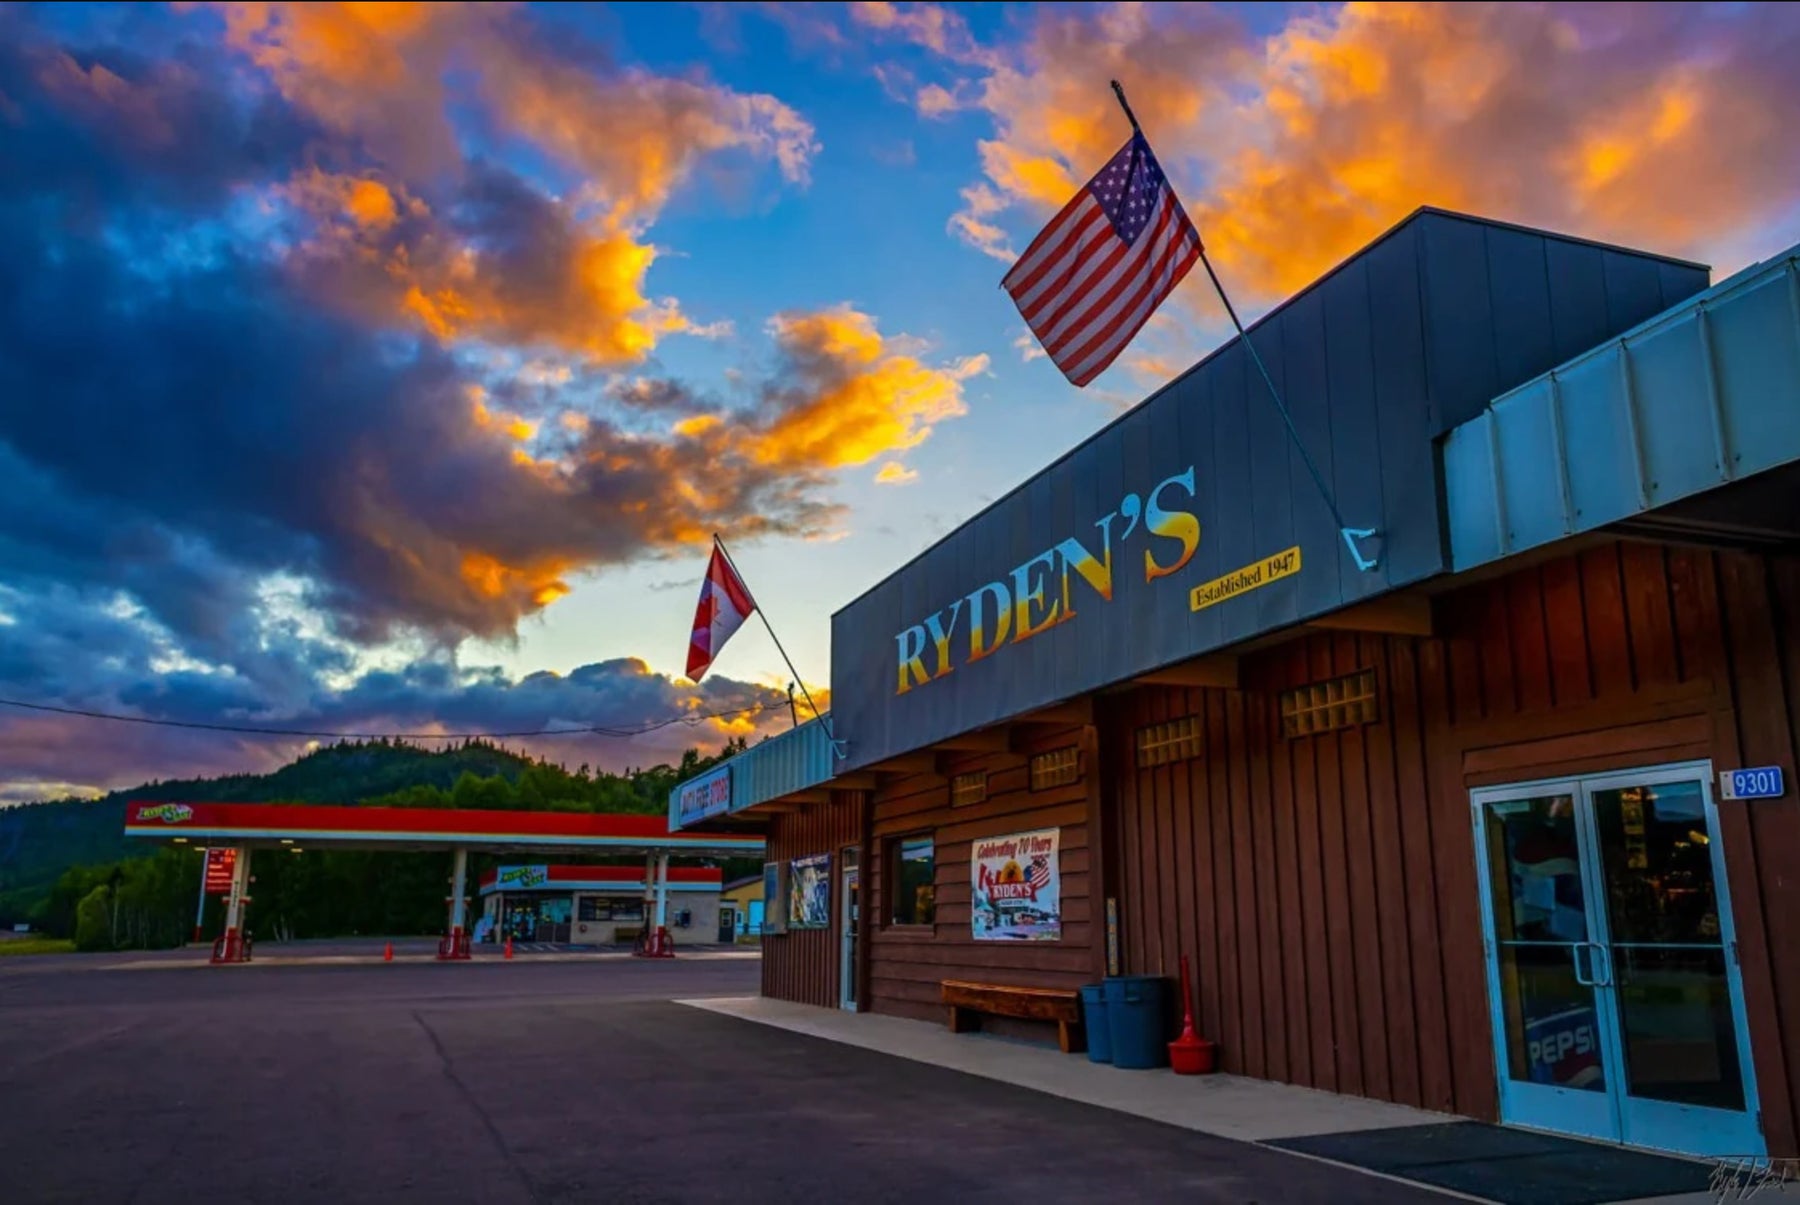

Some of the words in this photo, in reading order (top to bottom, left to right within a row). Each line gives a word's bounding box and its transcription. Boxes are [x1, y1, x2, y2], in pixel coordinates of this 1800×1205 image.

[895, 466, 1200, 695] RYDEN'S
[1195, 565, 1262, 605] Established
[1266, 551, 1296, 579] 1947
[1735, 771, 1776, 794] 9301
[1019, 837, 1031, 854] 70
[993, 883, 1032, 898] RYDEN'S
